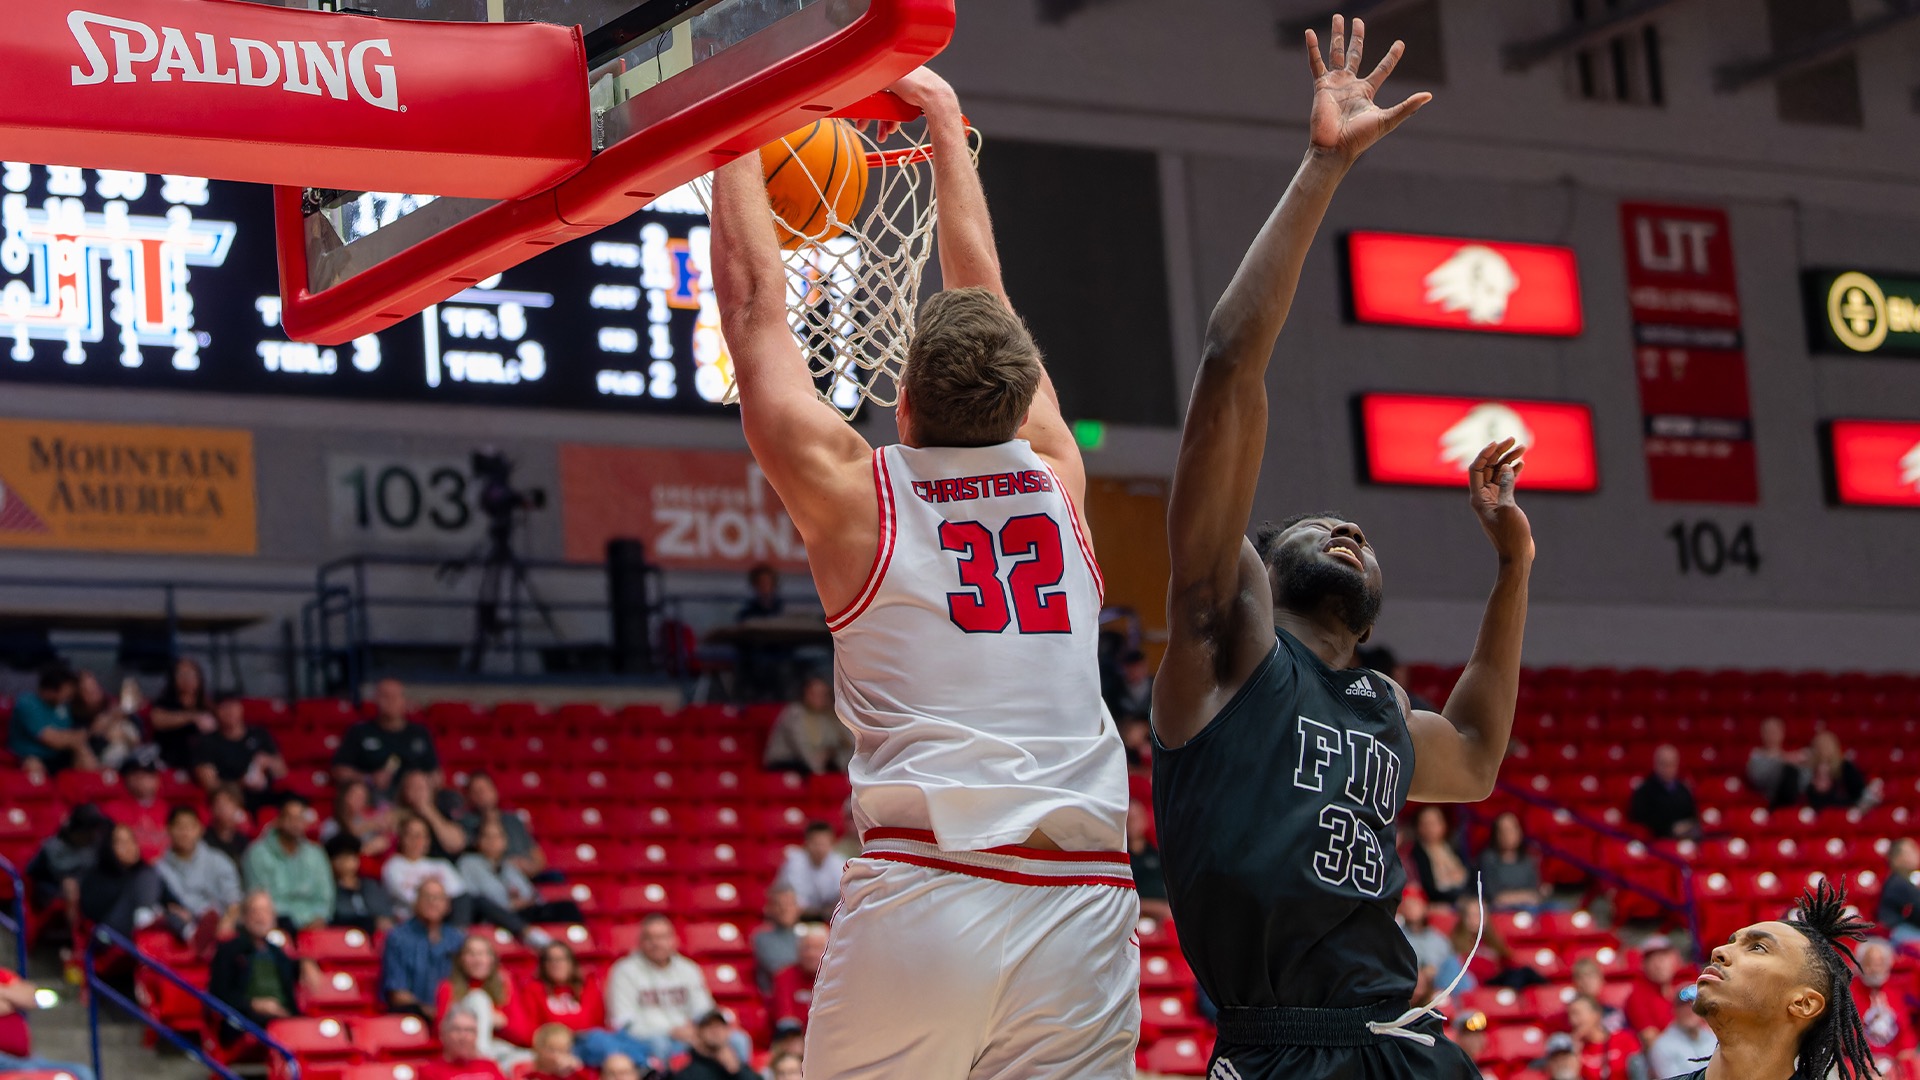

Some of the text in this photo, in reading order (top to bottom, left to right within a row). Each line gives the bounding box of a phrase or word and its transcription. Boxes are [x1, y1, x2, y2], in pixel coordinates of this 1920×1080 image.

[67, 10, 399, 112] SPALDING
[29, 436, 237, 479] MOUNTAIN
[49, 480, 223, 517] AMERICA
[340, 464, 470, 531] 103
[911, 469, 1054, 503] CHRISTENSE
[654, 508, 808, 560] ZION
[1667, 520, 1760, 576] 104
[937, 512, 1072, 634] 32
[1345, 687, 1377, 699] adidas
[1293, 715, 1400, 825] FIU
[1313, 803, 1384, 896] 33
